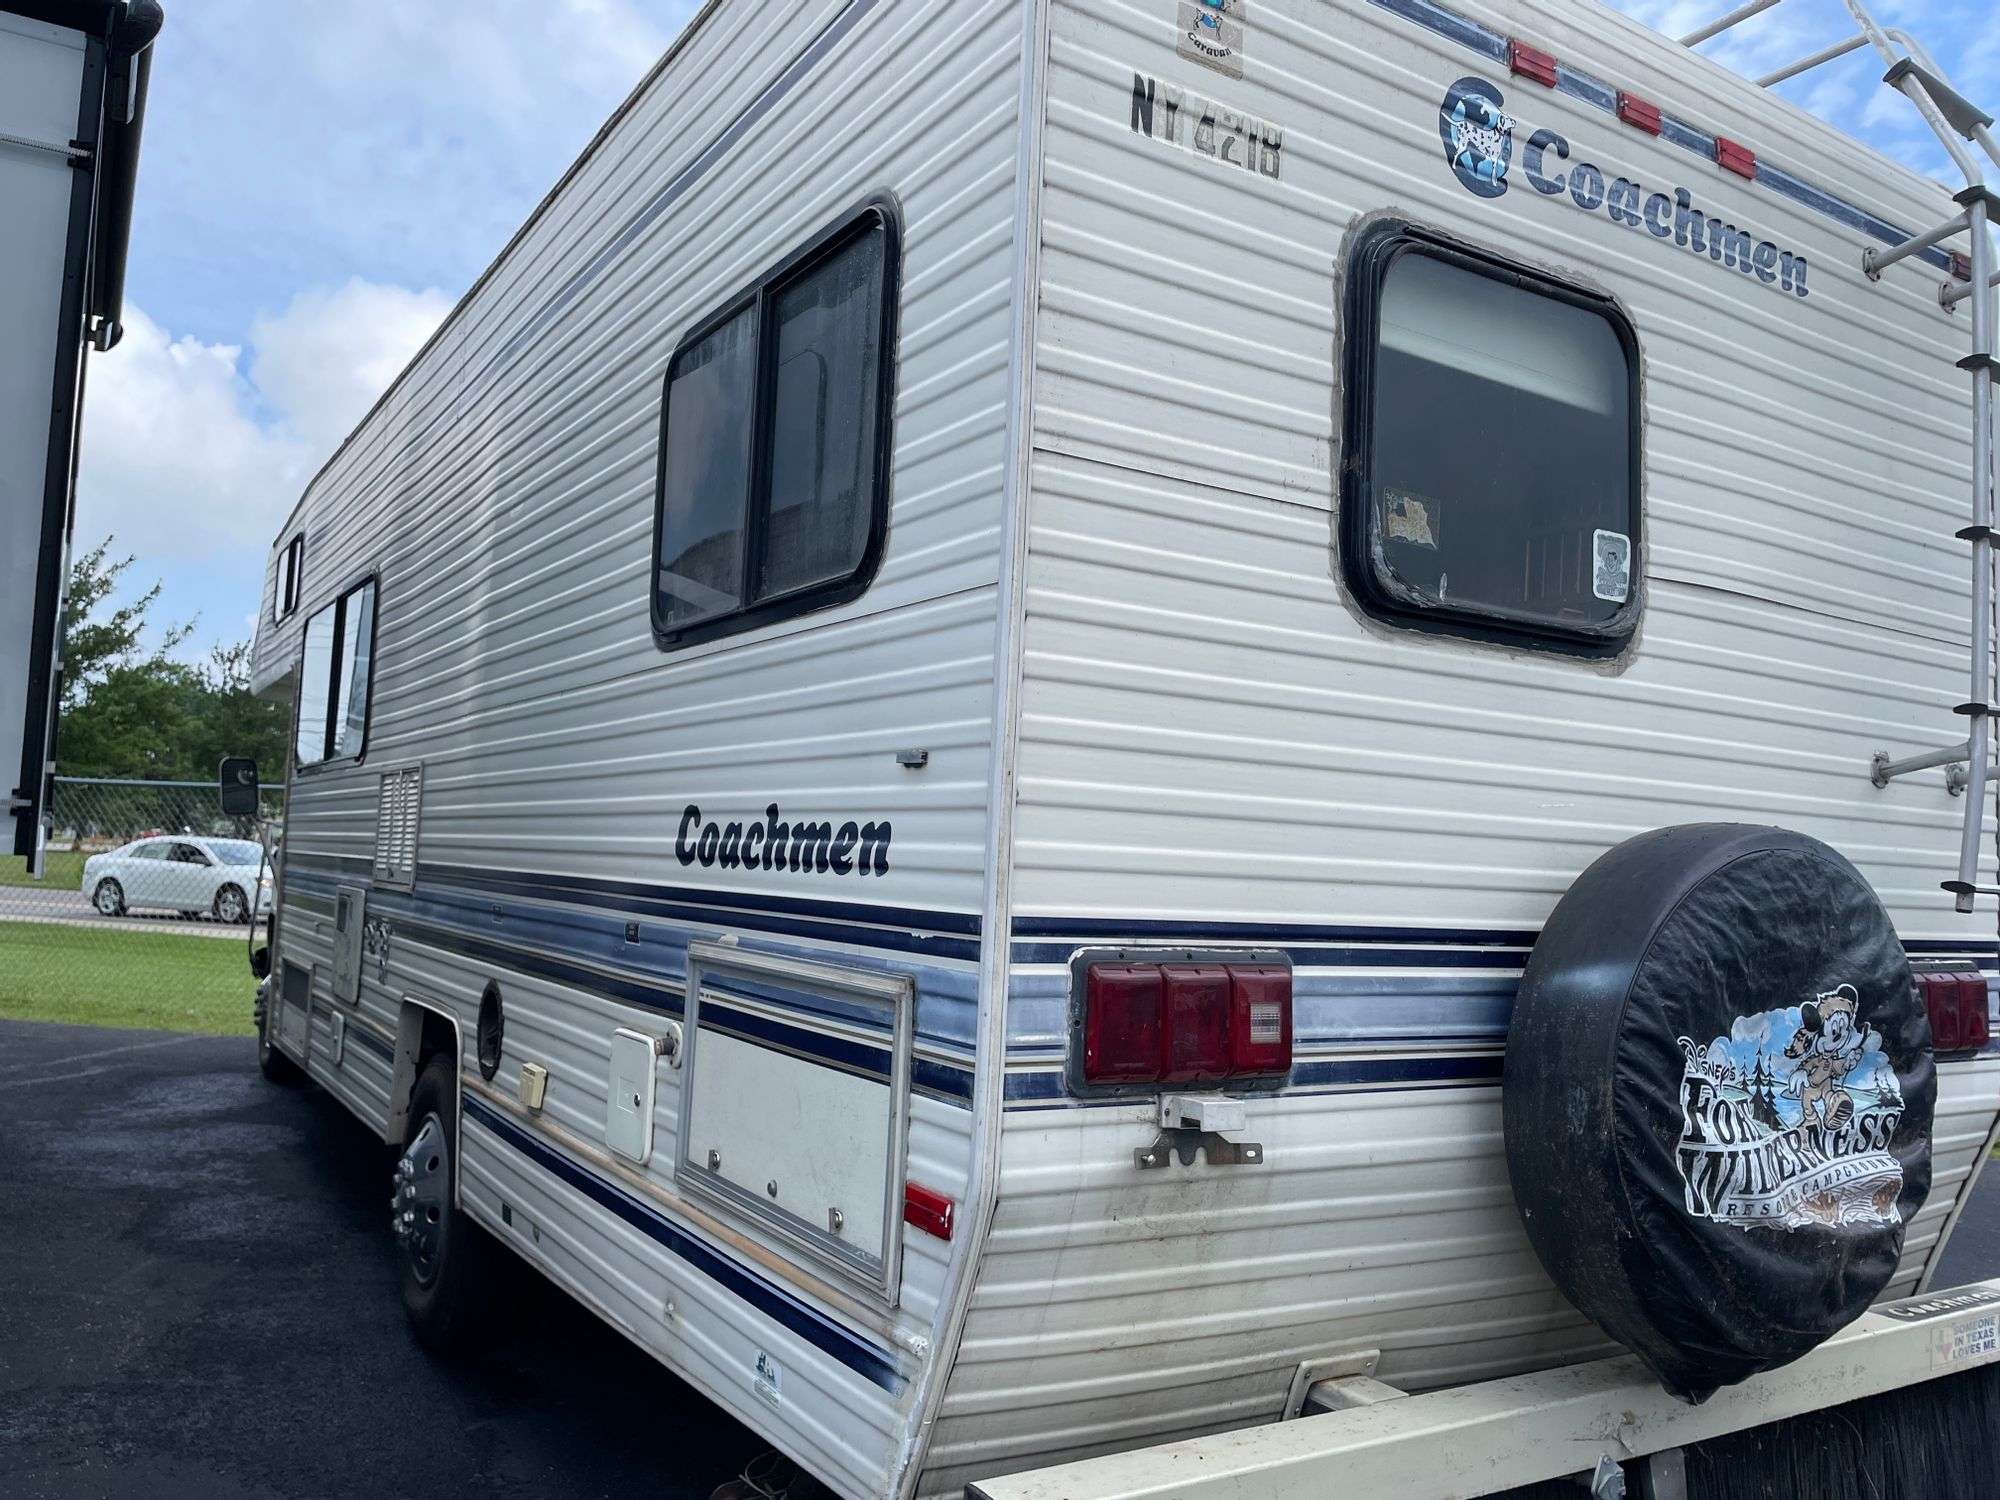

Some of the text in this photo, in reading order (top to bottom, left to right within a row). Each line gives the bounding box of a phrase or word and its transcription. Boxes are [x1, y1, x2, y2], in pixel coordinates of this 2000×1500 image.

[1187, 31, 1232, 58] Caravan
[1522, 127, 1810, 297] Coachmen
[675, 803, 892, 877] Coachmen
[1952, 1338, 1997, 1359] LOVES ME
[1954, 1327, 1995, 1347] IN TEXAS
